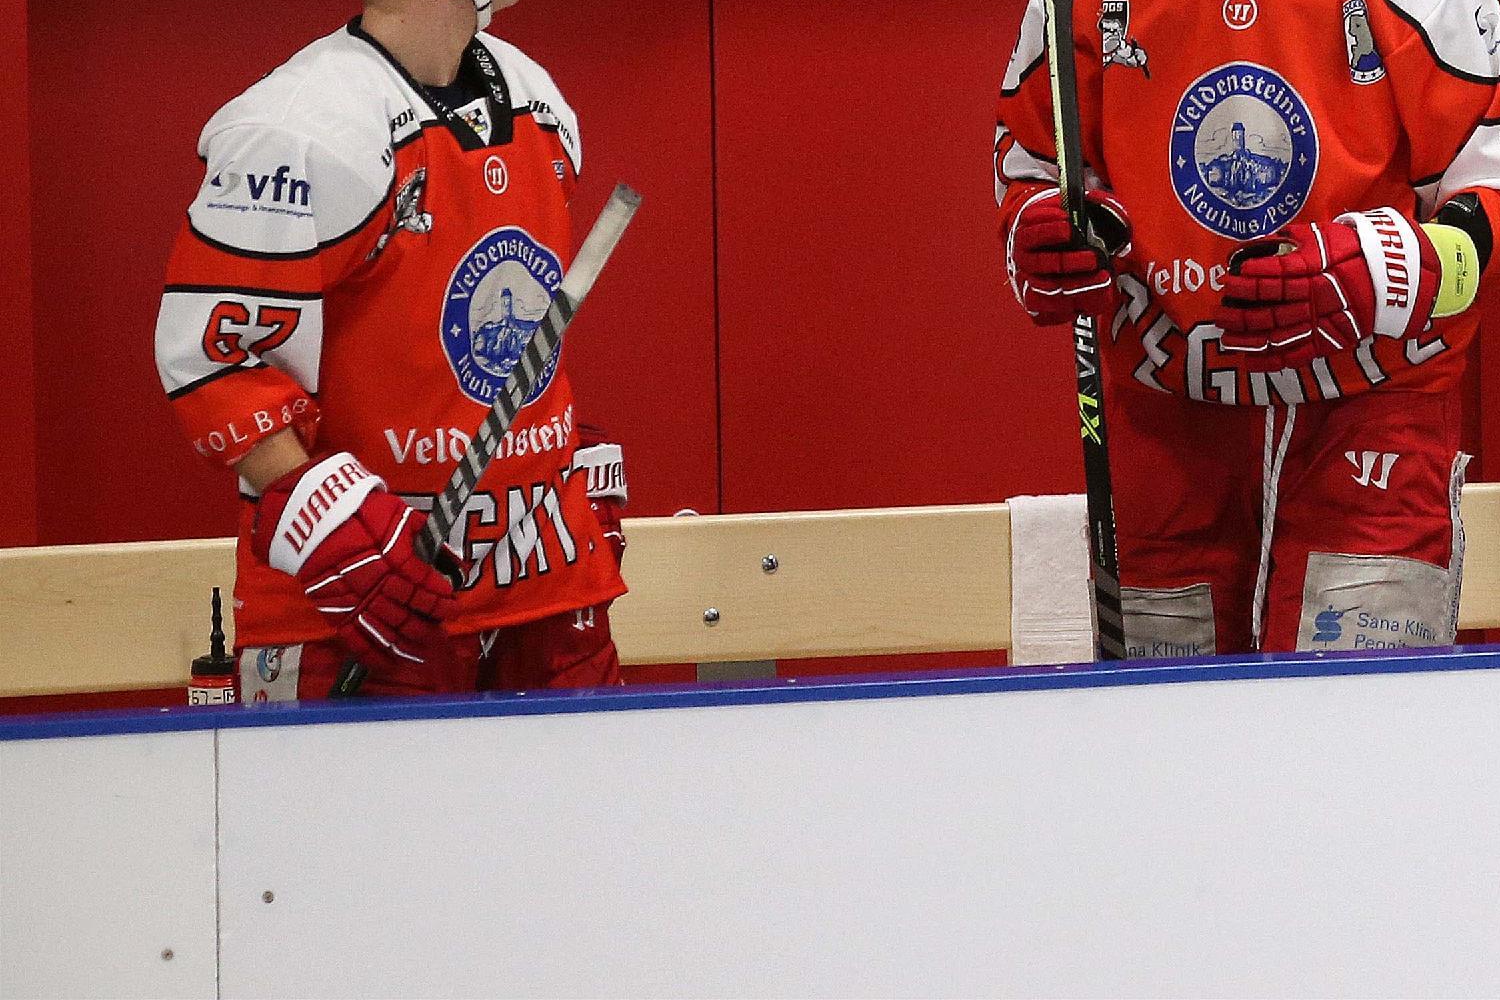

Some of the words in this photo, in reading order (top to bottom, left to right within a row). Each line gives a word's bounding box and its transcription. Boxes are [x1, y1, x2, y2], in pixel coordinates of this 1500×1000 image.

[1175, 74, 1307, 137] Veldensteiner
[1365, 211, 1410, 308] RRIOR
[202, 300, 302, 367] 67
[1356, 612, 1400, 633] Sana
